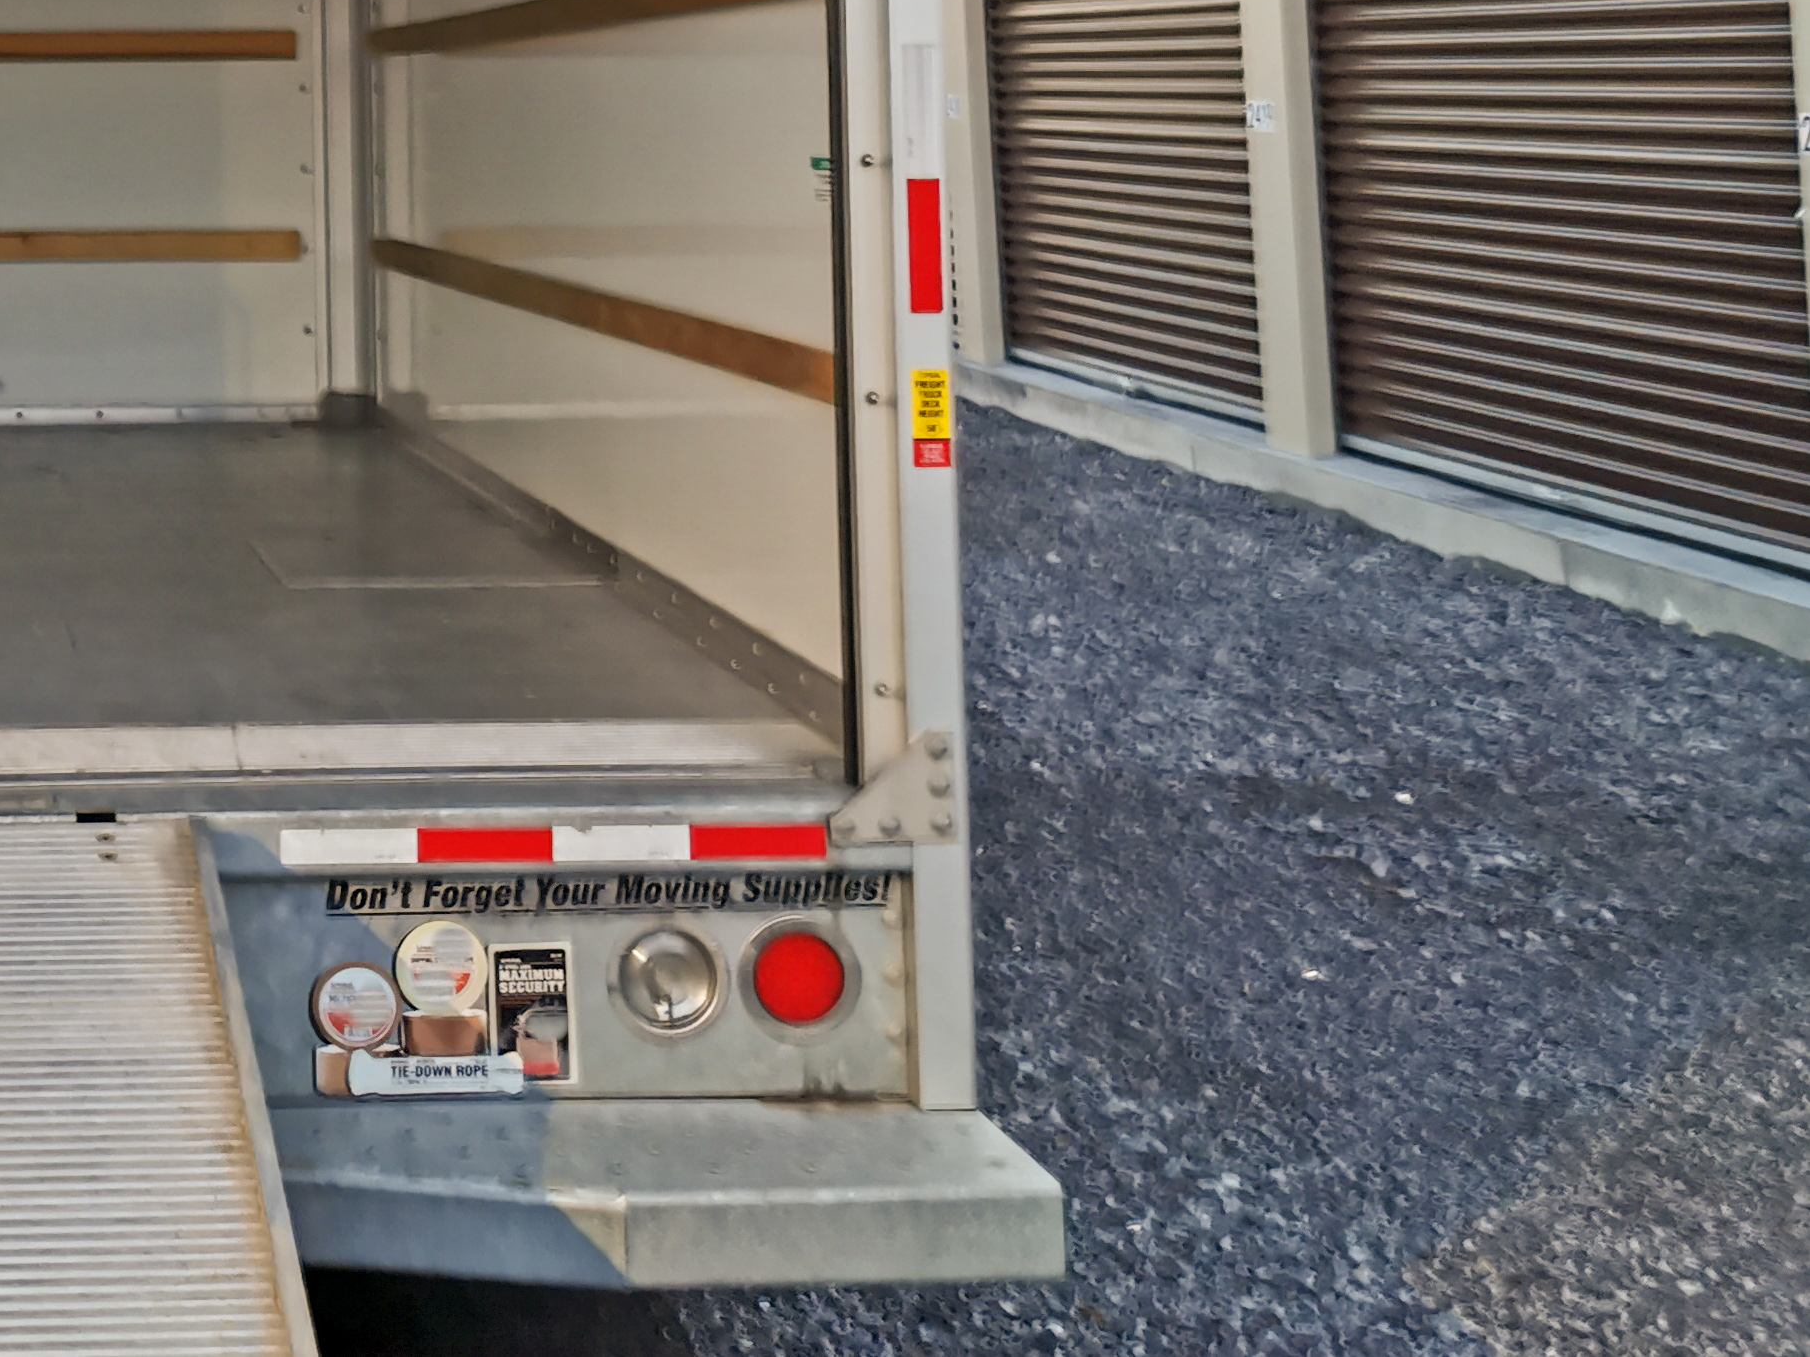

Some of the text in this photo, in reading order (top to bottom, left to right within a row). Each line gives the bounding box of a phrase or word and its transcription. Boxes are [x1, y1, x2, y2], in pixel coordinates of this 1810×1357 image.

[326, 878, 412, 910] Don't
[422, 876, 525, 913] Forget
[536, 875, 606, 910] Your
[615, 872, 731, 909] Moving
[499, 968, 564, 981] MAXIMUM
[499, 980, 565, 993] SECURITY
[391, 1065, 489, 1078] TIE-DOWN ROPE
